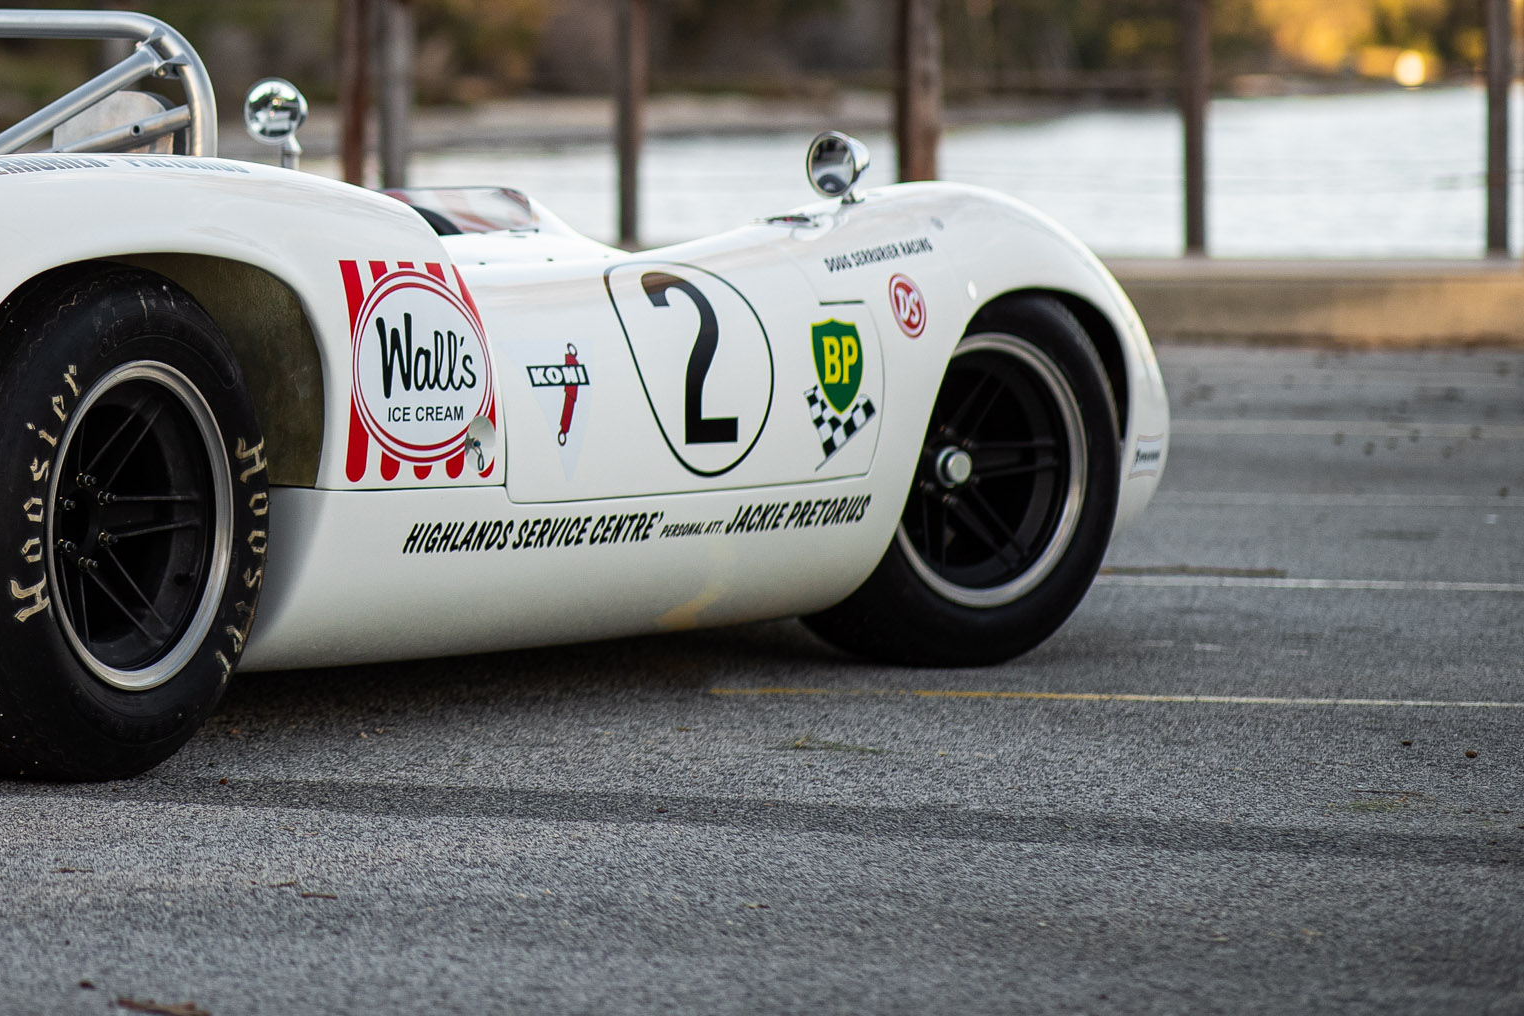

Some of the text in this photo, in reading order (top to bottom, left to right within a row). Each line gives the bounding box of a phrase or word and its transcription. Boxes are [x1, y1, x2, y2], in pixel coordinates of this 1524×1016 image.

[824, 253, 853, 273] DOUG
[898, 237, 933, 255] RACING
[895, 286, 922, 322] DS
[376, 312, 477, 399] Wall's
[530, 365, 586, 385] KONI
[640, 271, 739, 445] 2
[822, 335, 859, 384] BP
[387, 405, 465, 422] ICE CREAM
[402, 519, 514, 554] HIGHLANDS
[511, 515, 593, 550] SERVICE
[660, 522, 707, 539] PERSONAL
[725, 502, 790, 536] JACKIE
[784, 493, 872, 530] PRETORIUS
